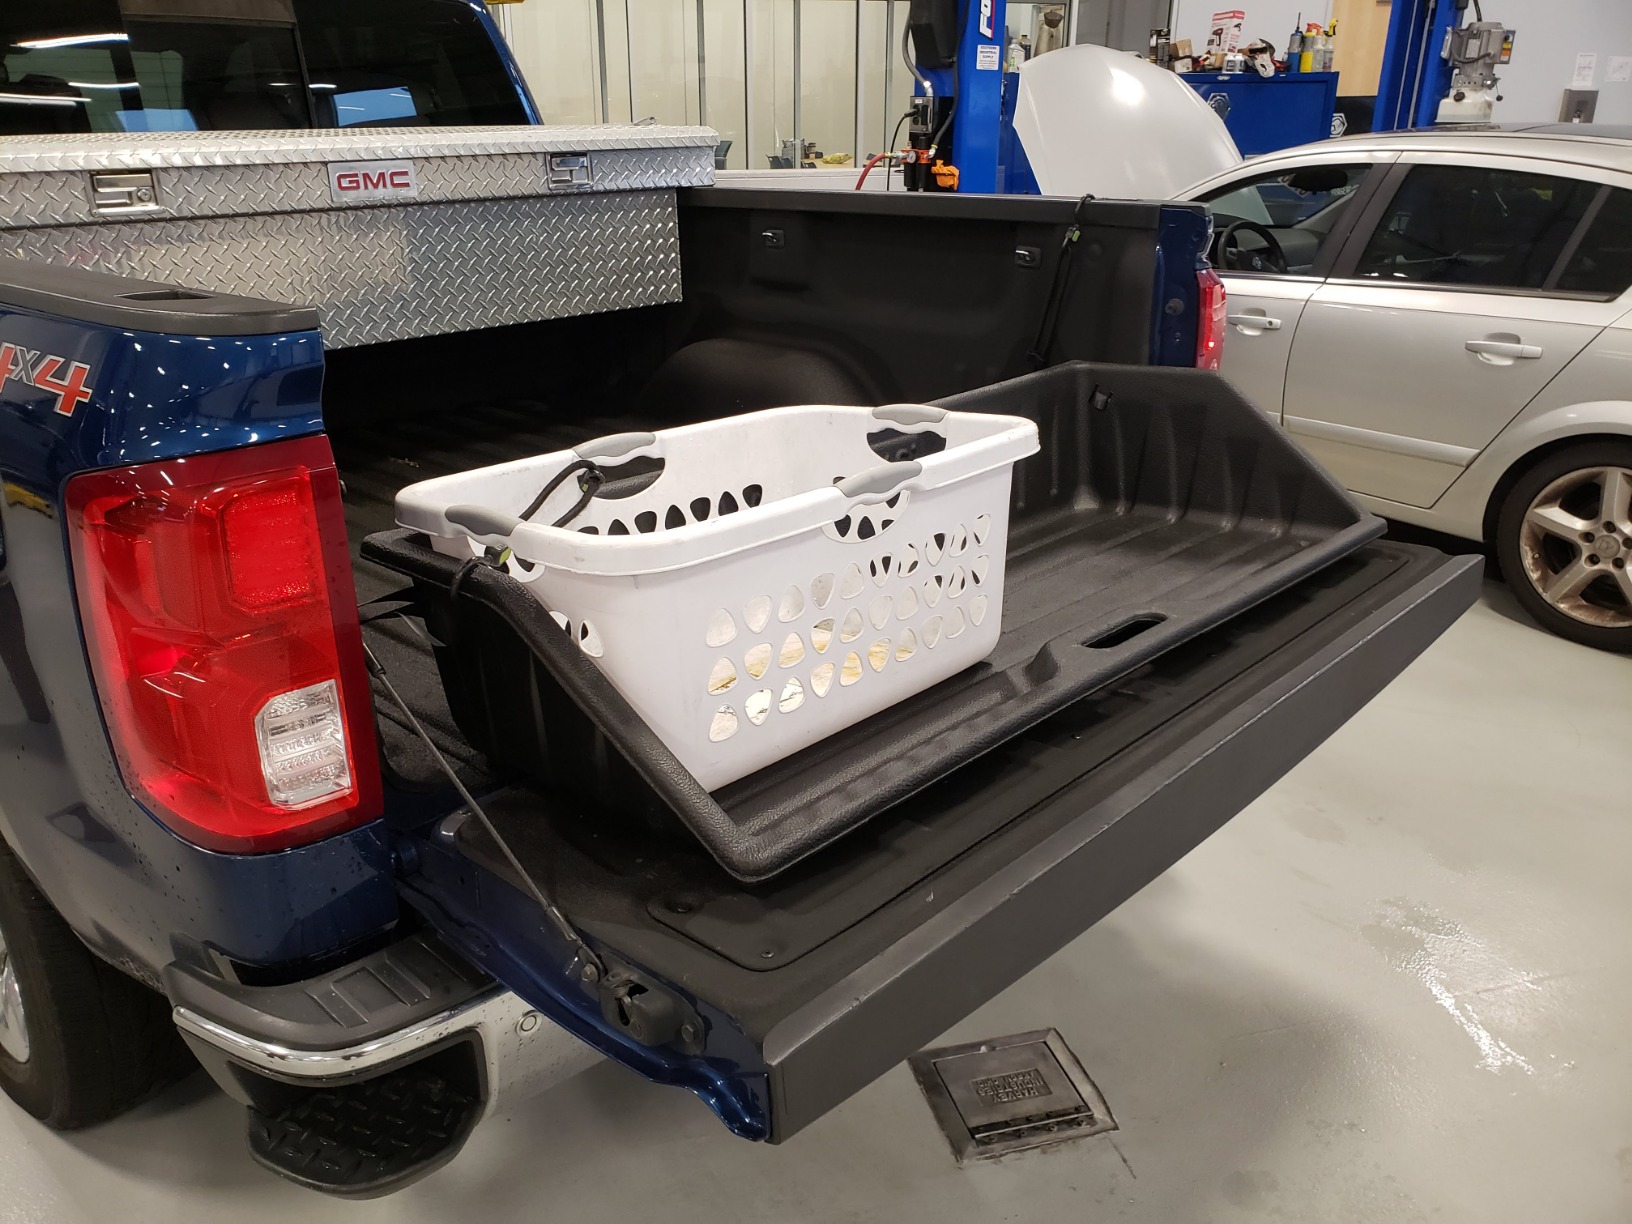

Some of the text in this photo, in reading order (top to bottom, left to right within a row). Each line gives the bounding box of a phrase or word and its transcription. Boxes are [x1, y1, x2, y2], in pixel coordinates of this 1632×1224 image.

[336, 170, 411, 191] GMC
[978, 1076, 1044, 1096] INDUSTRIES
[993, 1088, 1038, 1103] HARVEY
